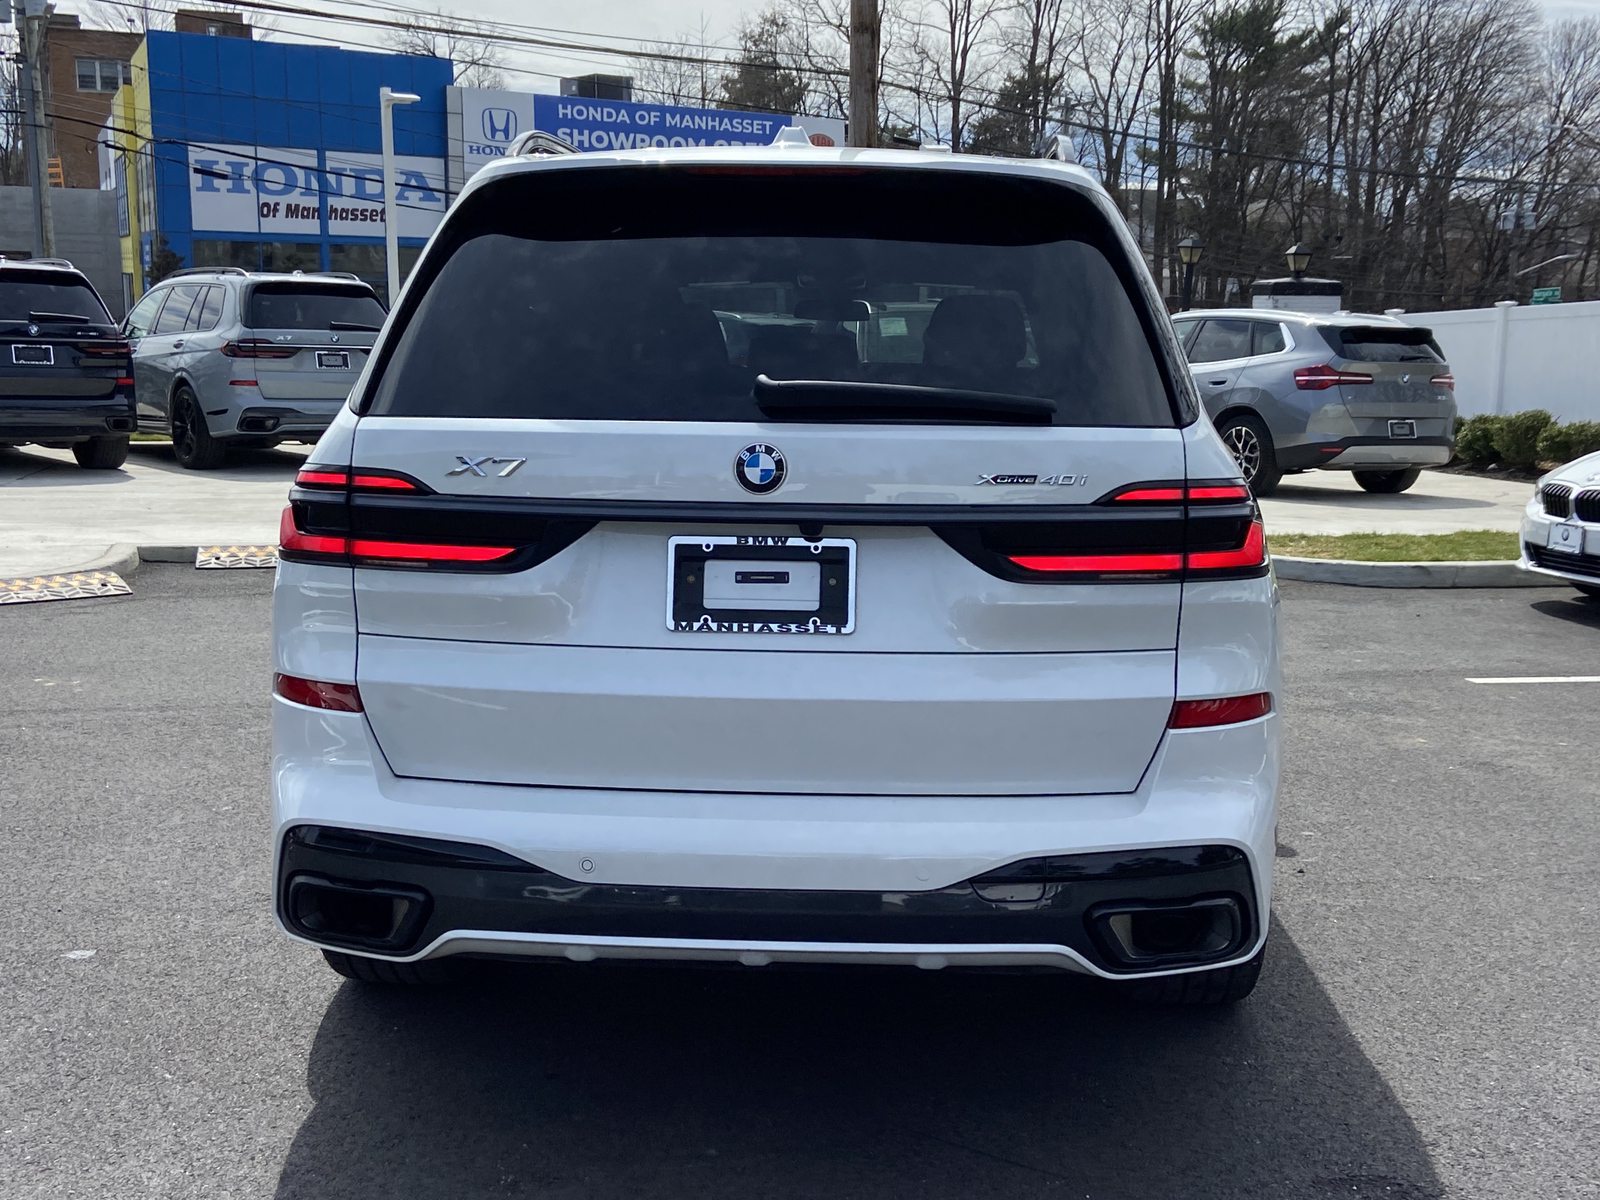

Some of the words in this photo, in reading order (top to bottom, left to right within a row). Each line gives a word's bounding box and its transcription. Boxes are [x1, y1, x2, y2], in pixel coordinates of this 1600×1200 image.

[558, 104, 630, 124] HONDA
[635, 110, 660, 126] OF
[666, 113, 773, 134] MANHASSET
[468, 145, 507, 157] HON
[194, 159, 441, 203] HONDA
[260, 202, 280, 219] Of
[740, 444, 781, 461] BMW
[444, 456, 527, 477] X7
[737, 536, 790, 546] BMW
[673, 622, 848, 634] MANHASSET
